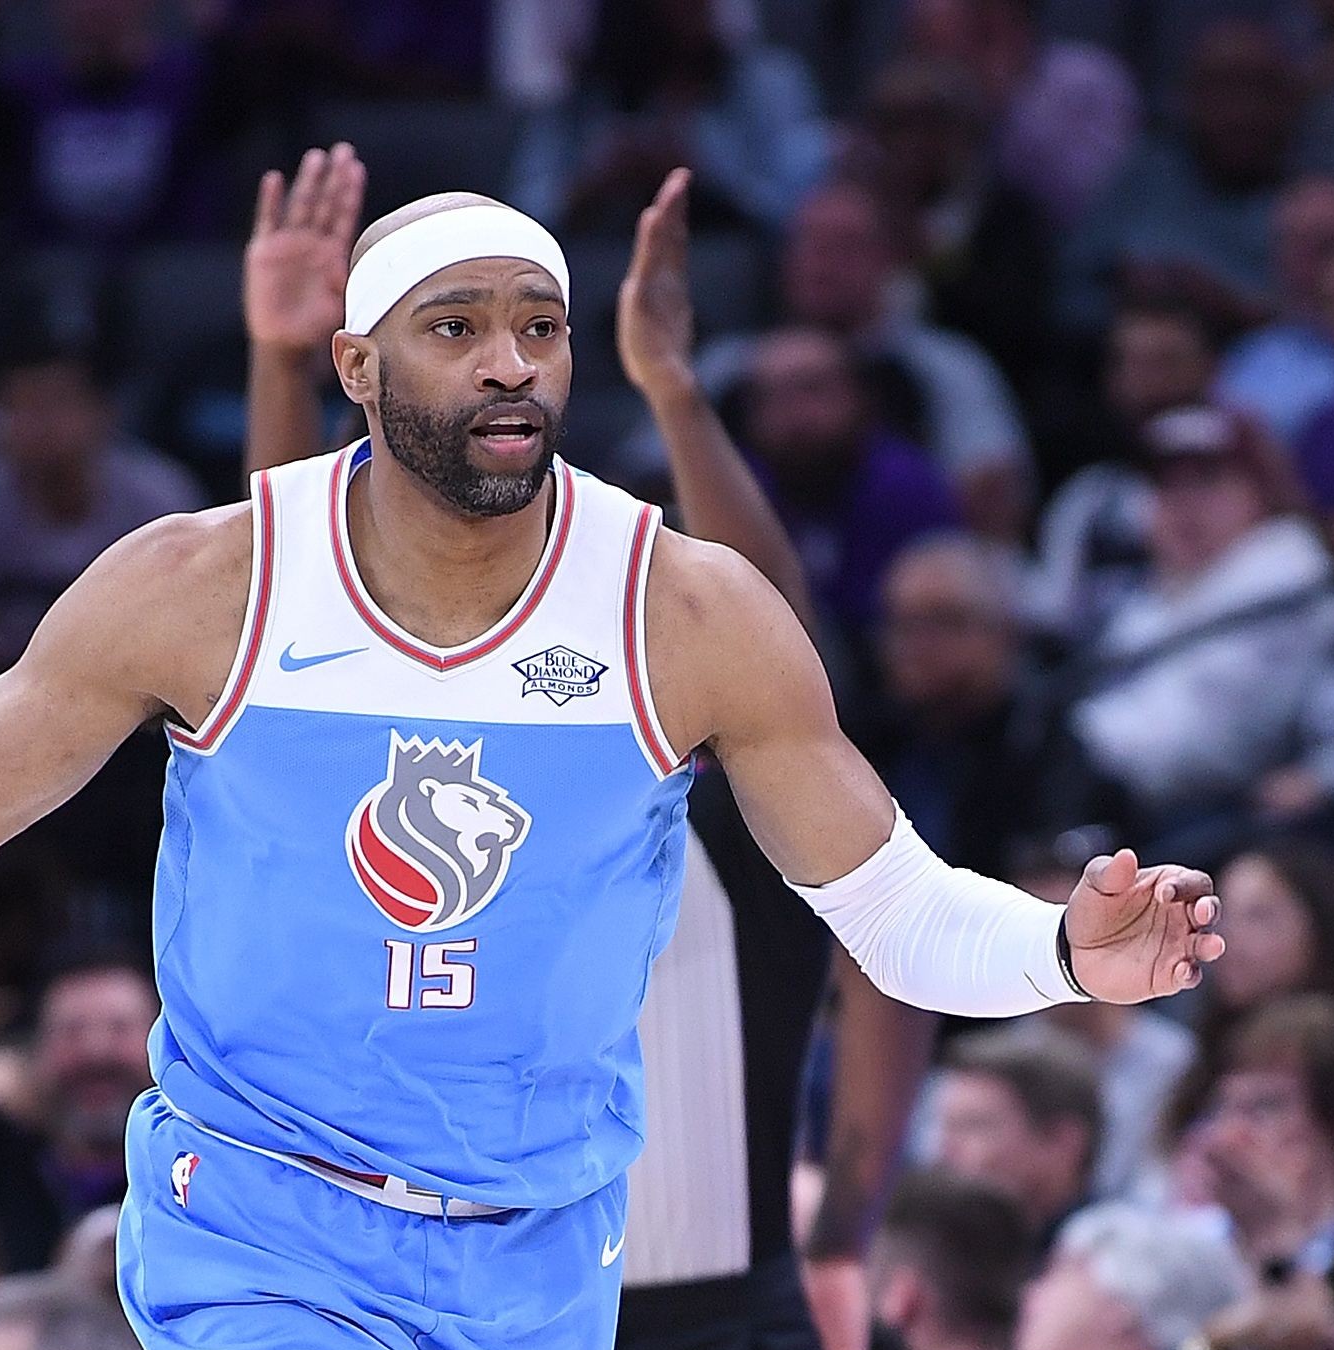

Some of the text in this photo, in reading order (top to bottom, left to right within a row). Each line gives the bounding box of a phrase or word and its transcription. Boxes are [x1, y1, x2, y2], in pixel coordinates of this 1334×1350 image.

[545, 652, 578, 667] BLUE
[526, 663, 596, 679] DIAMOND
[530, 680, 593, 693] ALMONDS
[384, 938, 477, 1010] 15
